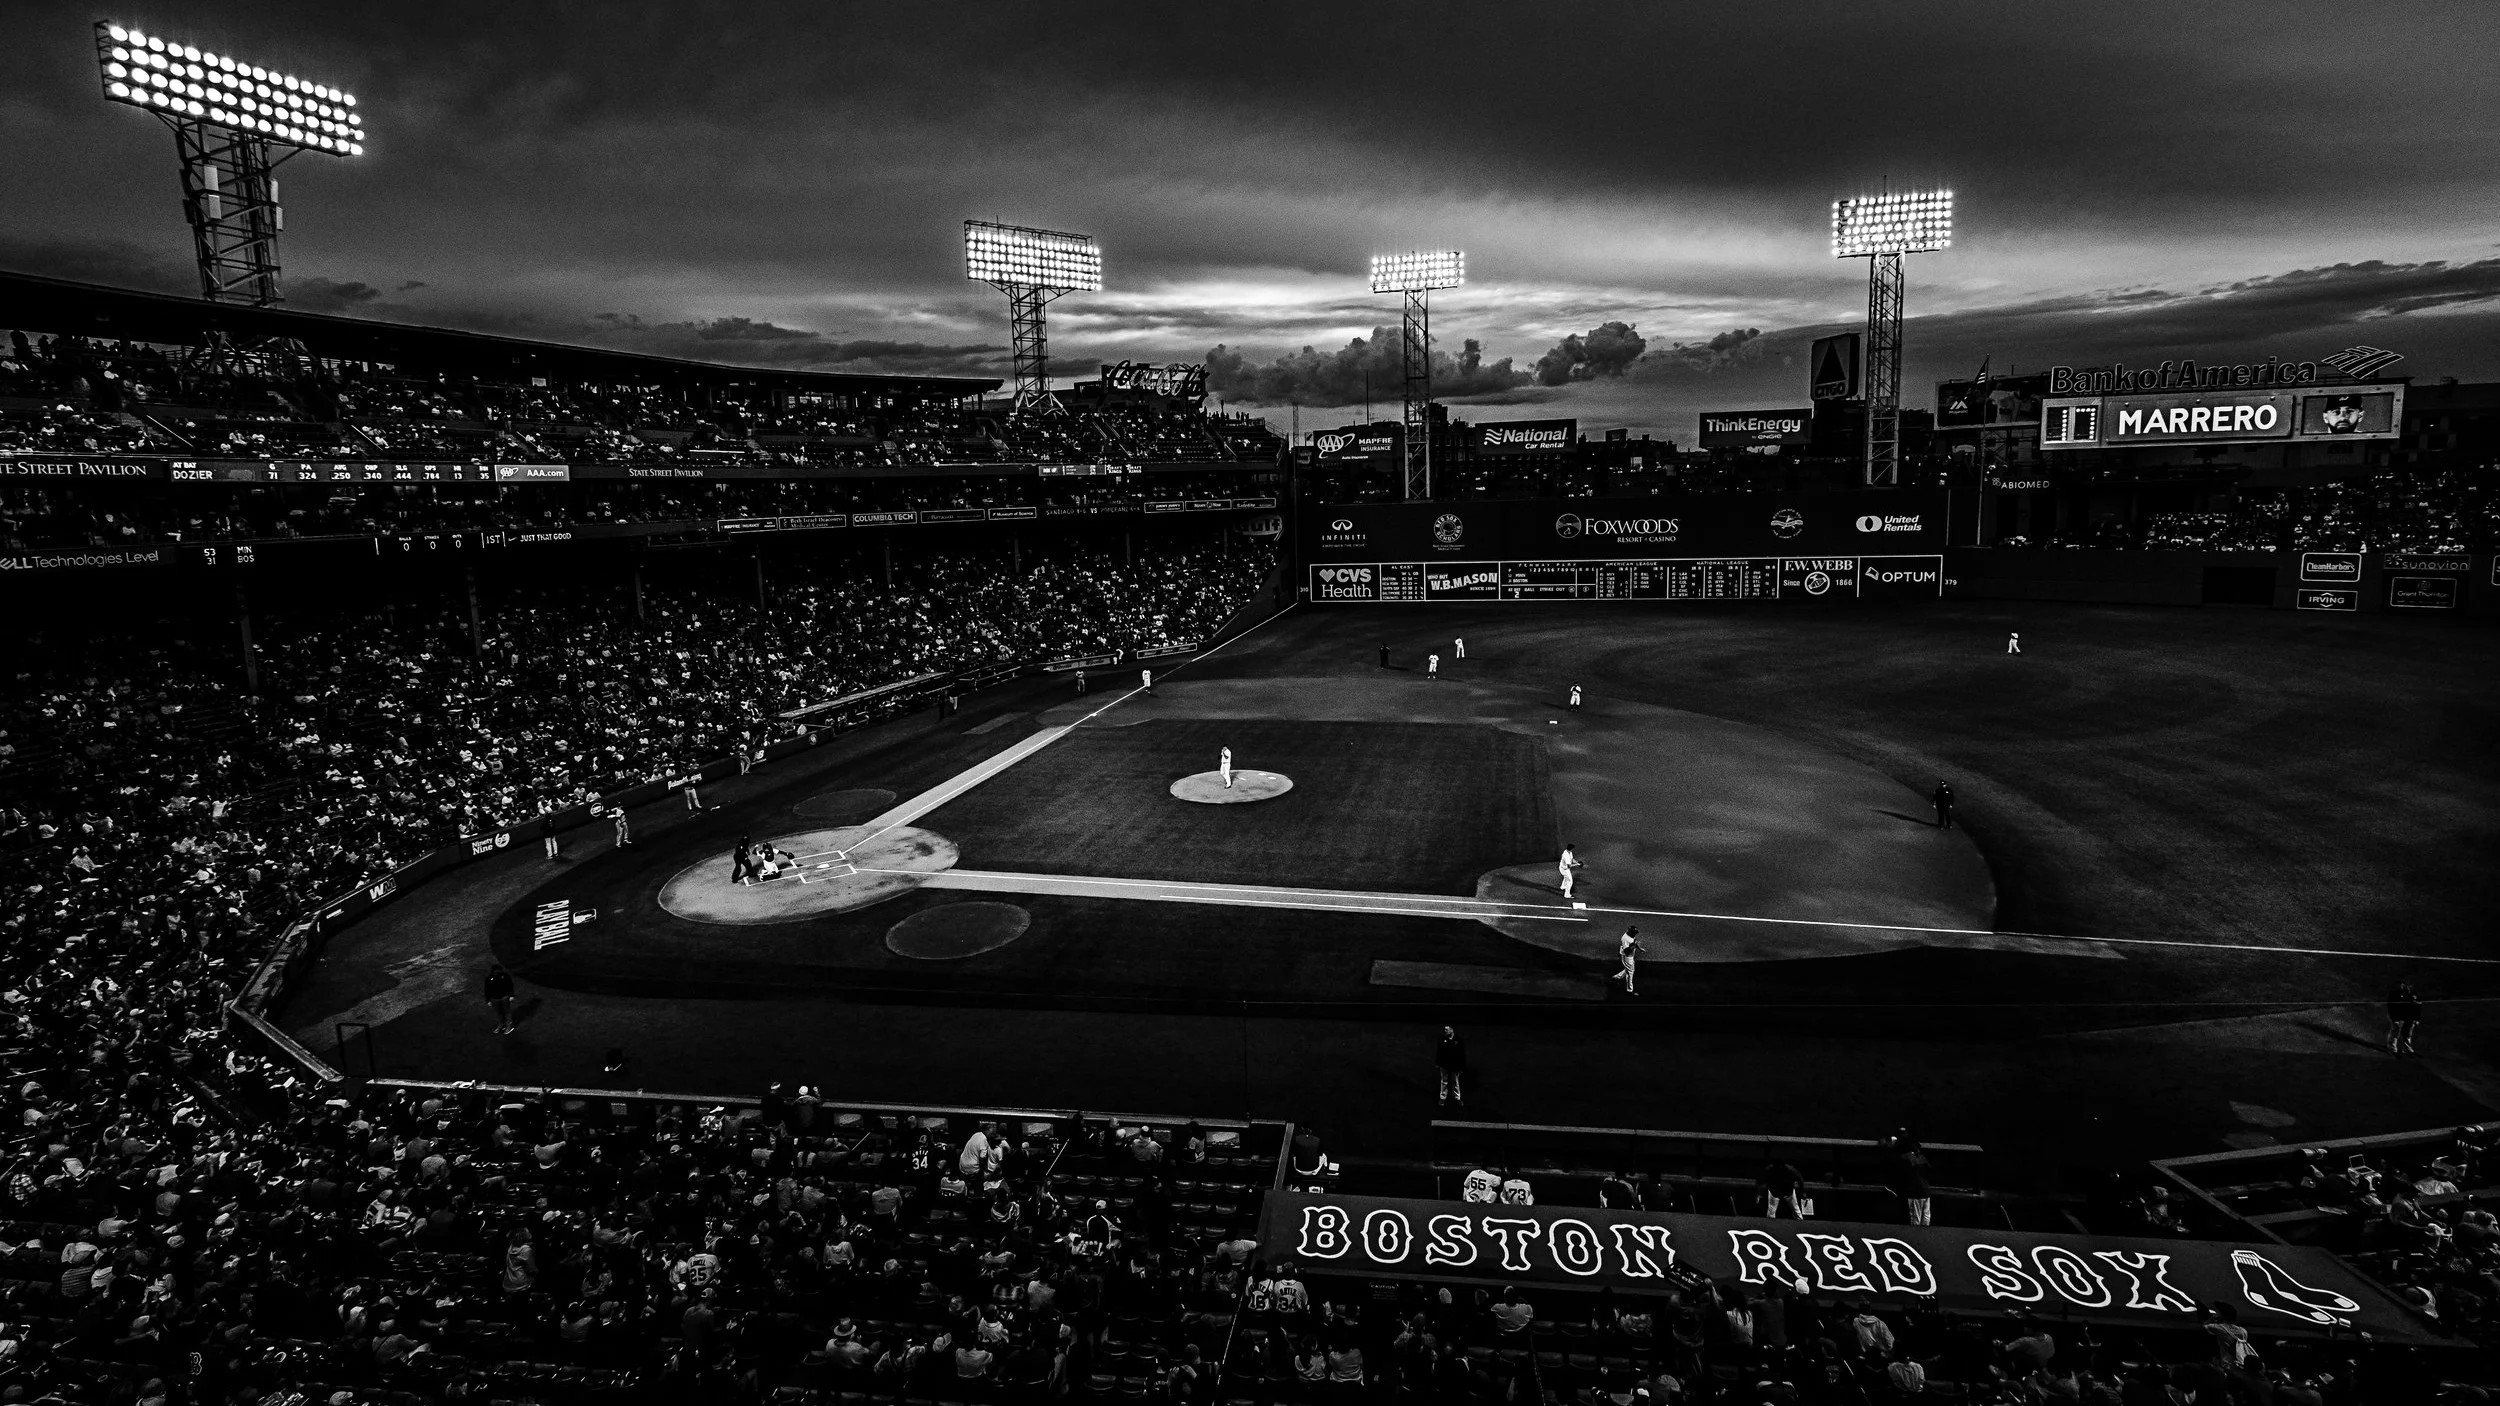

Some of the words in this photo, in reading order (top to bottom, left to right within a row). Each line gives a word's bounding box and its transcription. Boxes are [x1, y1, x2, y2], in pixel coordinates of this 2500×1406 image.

[2050, 363, 2134, 393] Bank
[2136, 360, 2173, 390] of
[2175, 355, 2317, 388] America
[1706, 418, 1800, 432] ThinkEnergy
[2118, 404, 2278, 435] MARRERO
[1358, 437, 1393, 445] MAPFRE
[1502, 427, 1567, 443] National
[1320, 436, 1341, 449] AAA
[18, 461, 73, 475] STREET
[78, 462, 148, 476] PAVILION
[527, 469, 564, 477] AAA.com
[629, 468, 649, 477] STATE
[650, 468, 673, 477] STREET
[674, 469, 704, 477] PAVILION
[173, 470, 213, 480] DOZIER
[299, 471, 316, 480] 324
[2001, 481, 2050, 489] ABIOMED
[854, 514, 893, 523] COLUMBIA
[894, 513, 913, 521] TECH
[1884, 515, 1919, 524] United
[1585, 518, 1679, 535] FOXWOODS
[1883, 523, 1922, 532] Rentals
[520, 533, 536, 542] JUST
[554, 532, 572, 540] GOOD
[1322, 533, 1367, 541] INFINITI
[203, 548, 216, 557] 53
[32, 553, 123, 569] Technologies
[126, 550, 159, 563] Level
[237, 555, 255, 563] BOS
[2402, 560, 2469, 570] sunovion
[1812, 560, 1854, 571] WEBB
[1336, 568, 1372, 583] CVS
[1881, 571, 1936, 583] OPTUM
[1322, 584, 1372, 598] Health
[2308, 596, 2345, 604] IRVING
[471, 837, 494, 849] Ninety
[472, 844, 494, 856] Nine
[911, 1156, 928, 1170] 34
[1508, 1188, 1526, 1201] 73
[1296, 1205, 1676, 1278] BOSTON
[1727, 1229, 1938, 1297] RED
[1967, 1243, 2198, 1313] SOX
[690, 1267, 707, 1283] 25
[1279, 1297, 1297, 1311] 34
